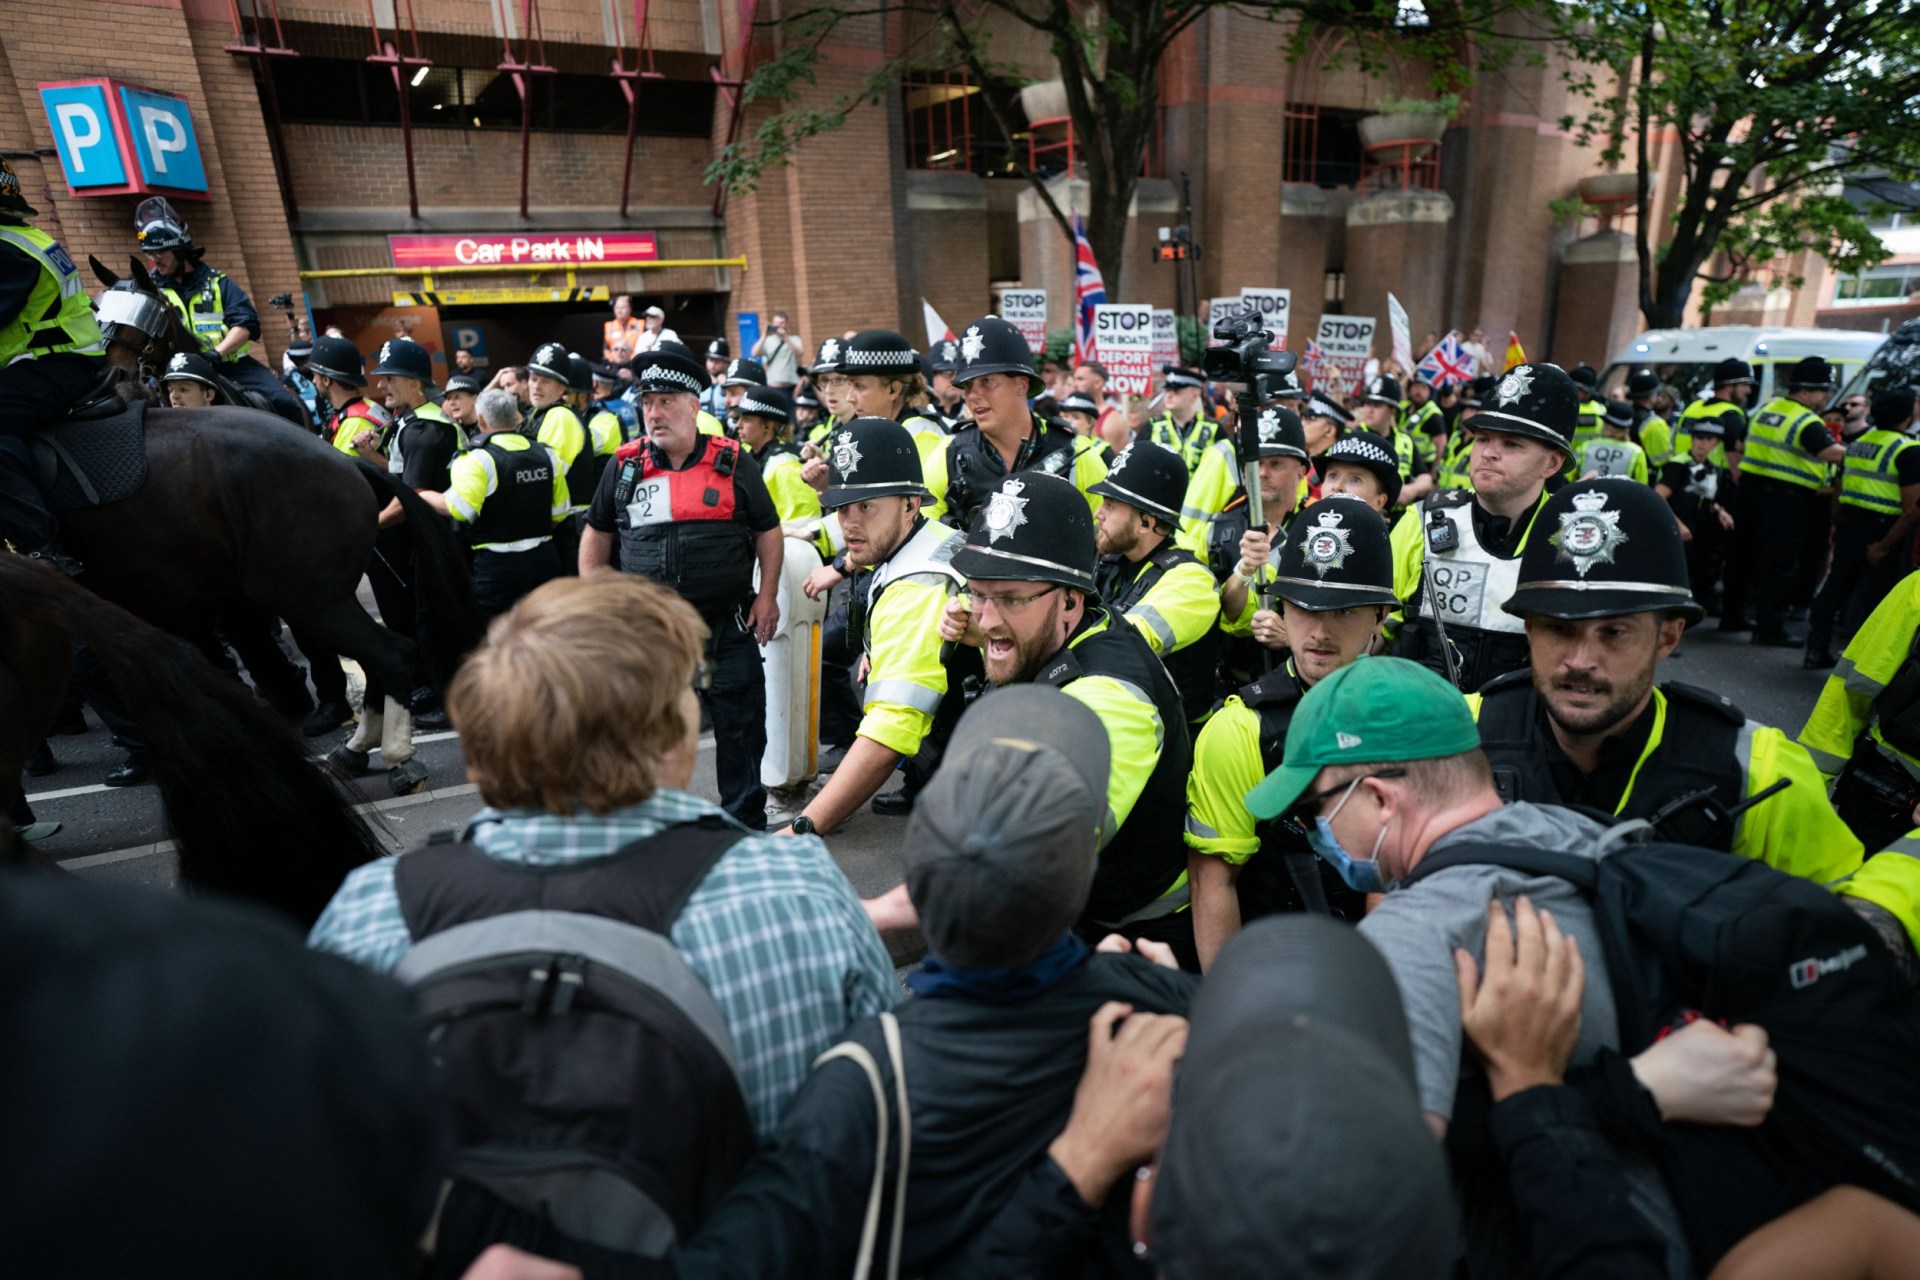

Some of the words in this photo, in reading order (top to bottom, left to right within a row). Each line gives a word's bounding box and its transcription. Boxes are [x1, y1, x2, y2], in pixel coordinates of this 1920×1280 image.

[56, 103, 101, 173] P
[139, 105, 188, 173] P
[455, 239, 505, 264] Car
[511, 238, 570, 262] Park
[576, 237, 604, 260] IN
[1004, 294, 1045, 308] STOP
[1243, 295, 1287, 313] STOP
[1212, 304, 1241, 318] STO
[1098, 312, 1150, 330] STOP
[1153, 315, 1173, 328] TOP
[1262, 320, 1284, 328] OATS
[458, 329, 480, 348] P
[1320, 322, 1372, 339] STOP
[1099, 335, 1115, 344] THE
[1118, 335, 1150, 345] BOATS
[1337, 343, 1368, 353] BOATS
[1098, 351, 1150, 364] DEPORT
[1103, 377, 1149, 394] NOW
[1595, 446, 1624, 463] QP
[516, 467, 548, 483] POLICE
[636, 484, 660, 502] QP
[641, 502, 653, 517] 2
[1433, 567, 1472, 589] QP
[1436, 591, 1468, 614] 3C
[1048, 663, 1069, 679] 4072
